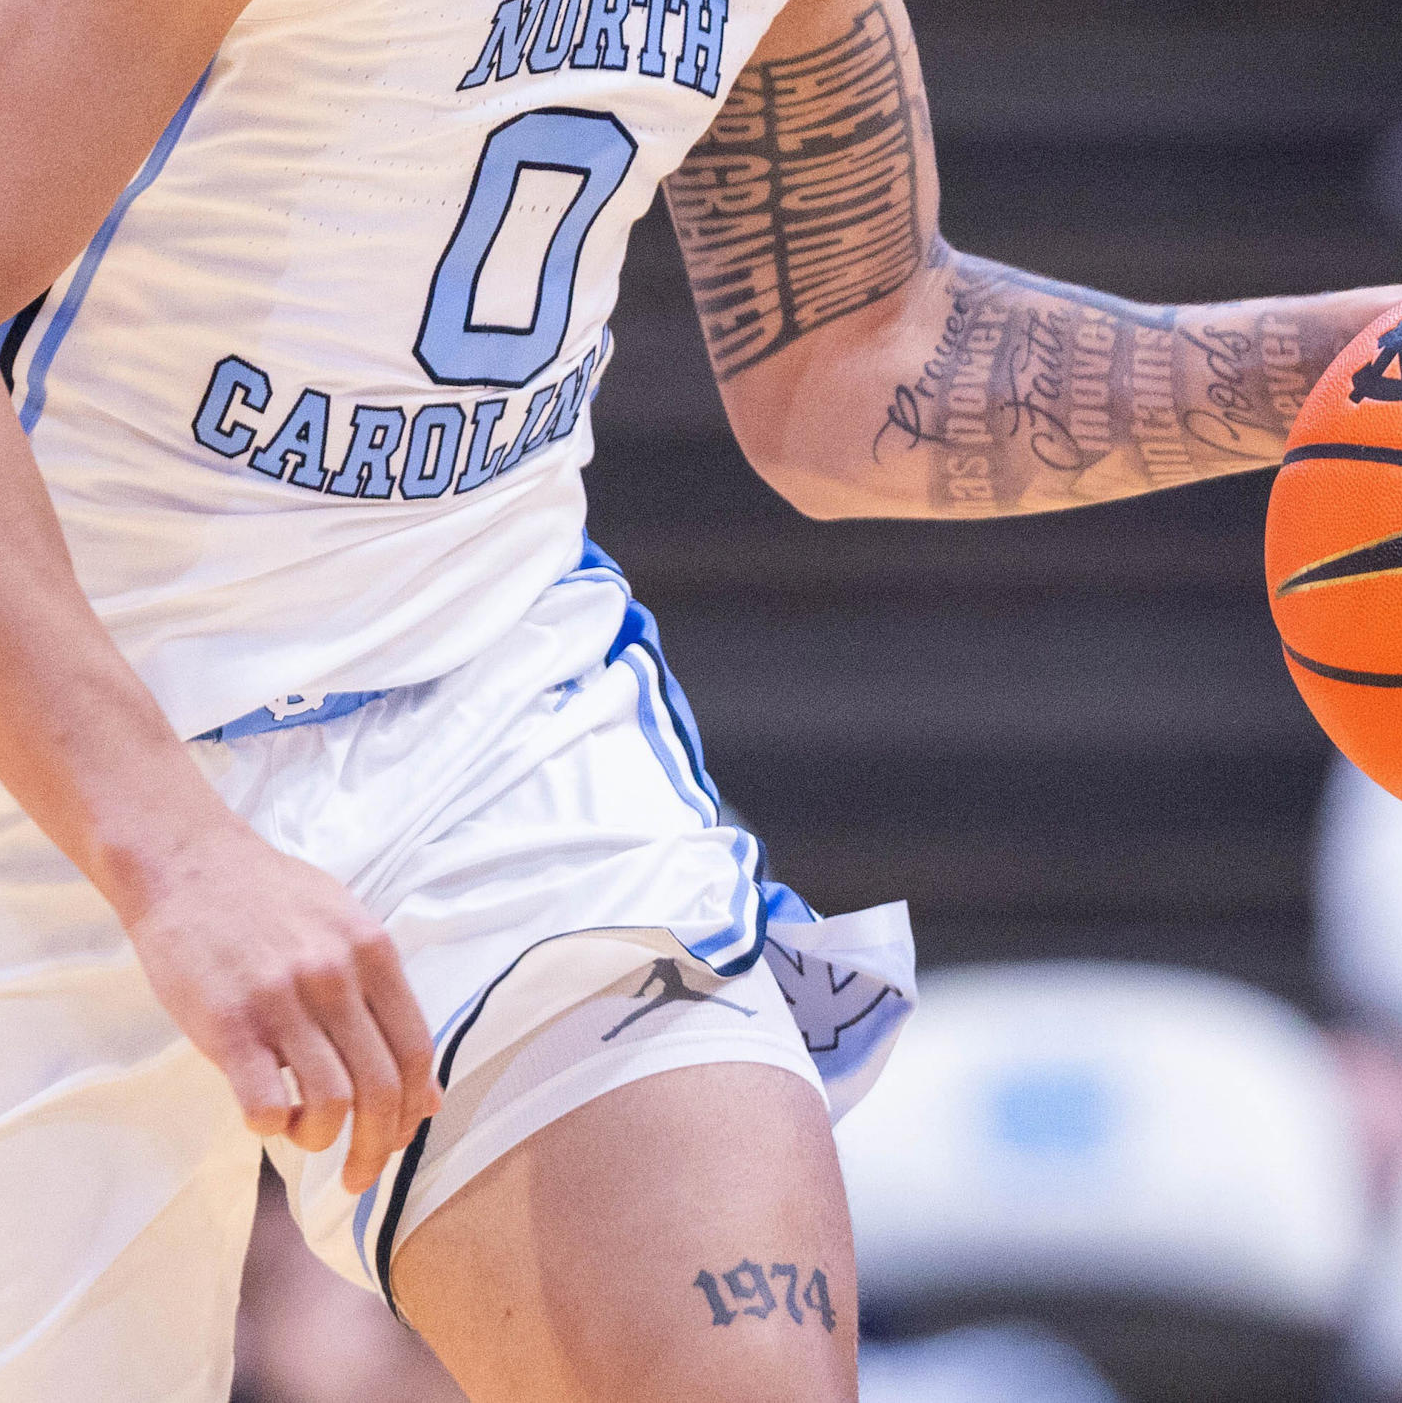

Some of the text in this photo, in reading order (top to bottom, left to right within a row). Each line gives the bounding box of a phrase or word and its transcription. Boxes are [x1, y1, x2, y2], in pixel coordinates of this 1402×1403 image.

[411, 106, 638, 388] 0
[769, 4, 919, 334] TAKE NOTHING
[668, 154, 785, 372] GRANTED
[192, 323, 610, 500] CAROLIN
[945, 302, 1010, 444] power
[997, 307, 1084, 472] Faith
[1260, 315, 1306, 430] ever
[692, 1259, 837, 1333] 1974
